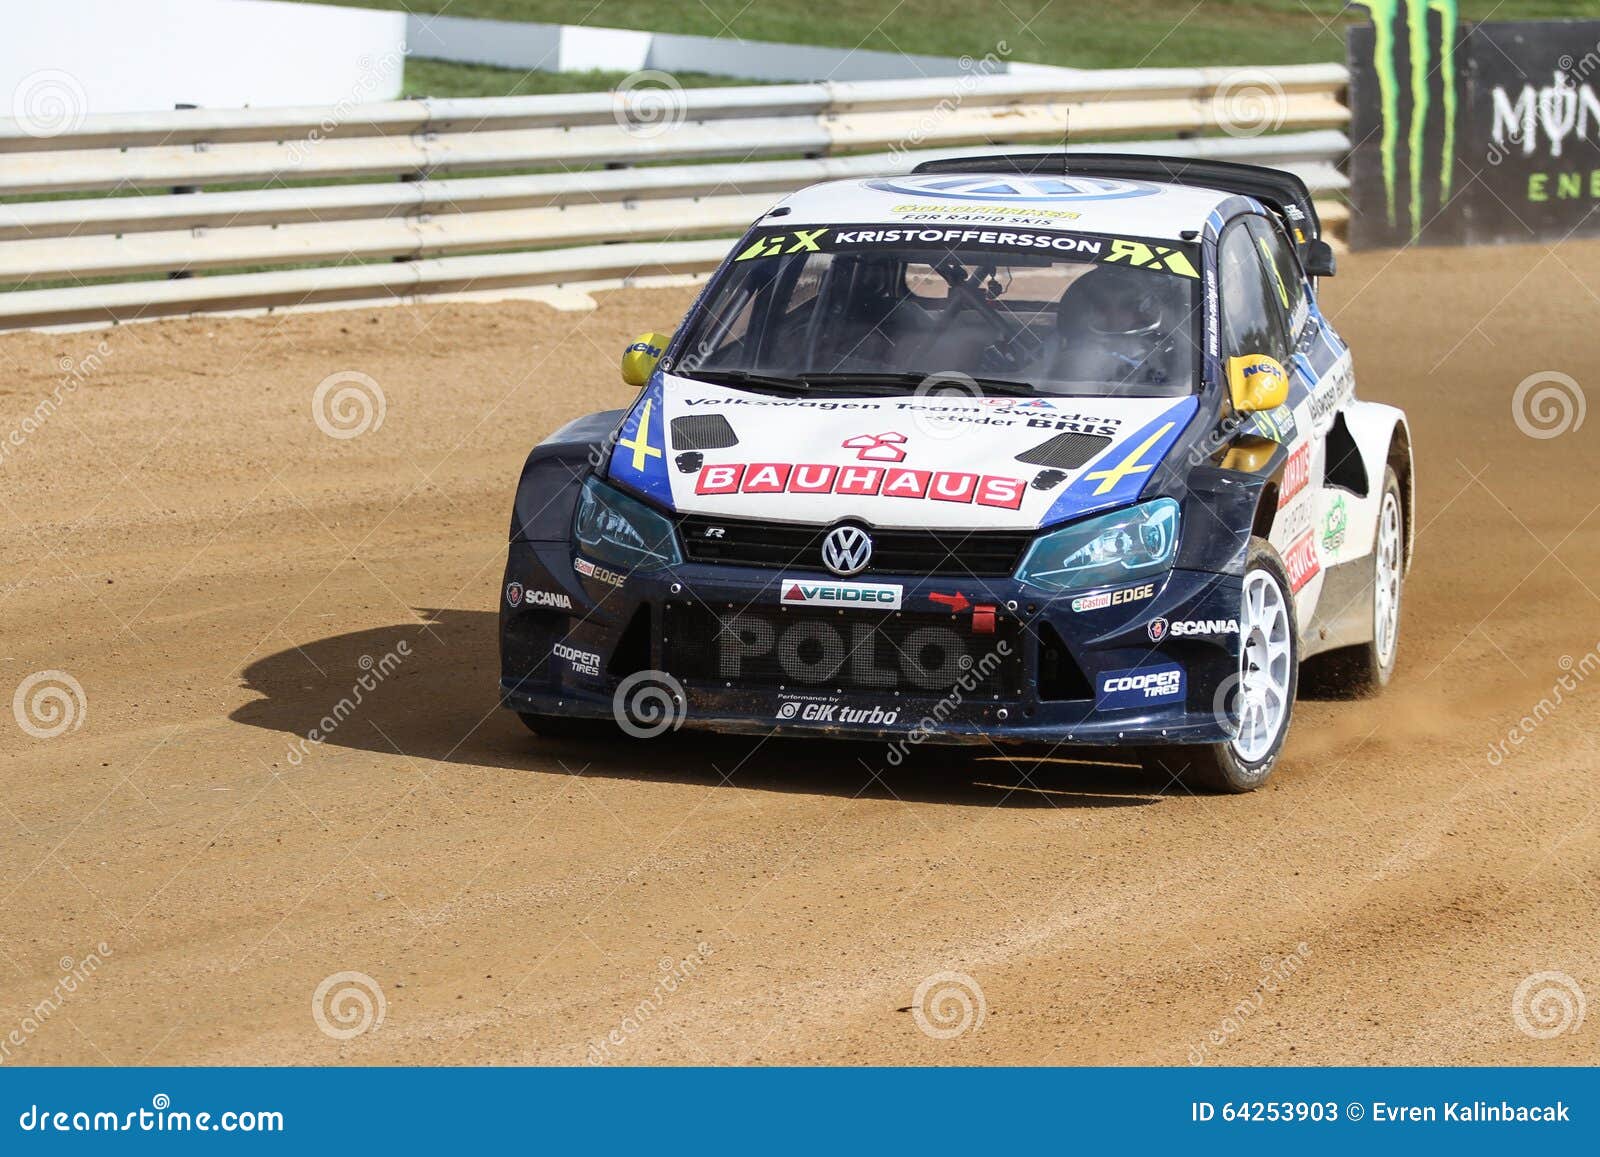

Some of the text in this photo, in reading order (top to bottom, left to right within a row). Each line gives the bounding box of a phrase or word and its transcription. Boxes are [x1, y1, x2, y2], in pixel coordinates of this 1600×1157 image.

[1008, 217, 1053, 225] SKIS
[835, 229, 1101, 254] KRISTOFFERSSON
[684, 398, 1123, 425] Volkswagen Team Sweden
[1026, 418, 1118, 436] BRIS
[701, 465, 1018, 503] BAUHAUS
[704, 526, 726, 538] R
[593, 566, 628, 588] EDGE
[525, 589, 572, 609] SCANIA
[800, 585, 895, 603] VEIDEC
[1081, 583, 1154, 610] Castrol EDGE
[1170, 619, 1240, 637] SCANIA
[553, 643, 601, 668] COOPER
[719, 614, 968, 690] POLO
[571, 661, 600, 677] TIRES
[1103, 670, 1181, 693] COOPER
[1143, 684, 1180, 698] TIRES
[777, 693, 828, 701] Performance
[838, 705, 898, 725] turbo
